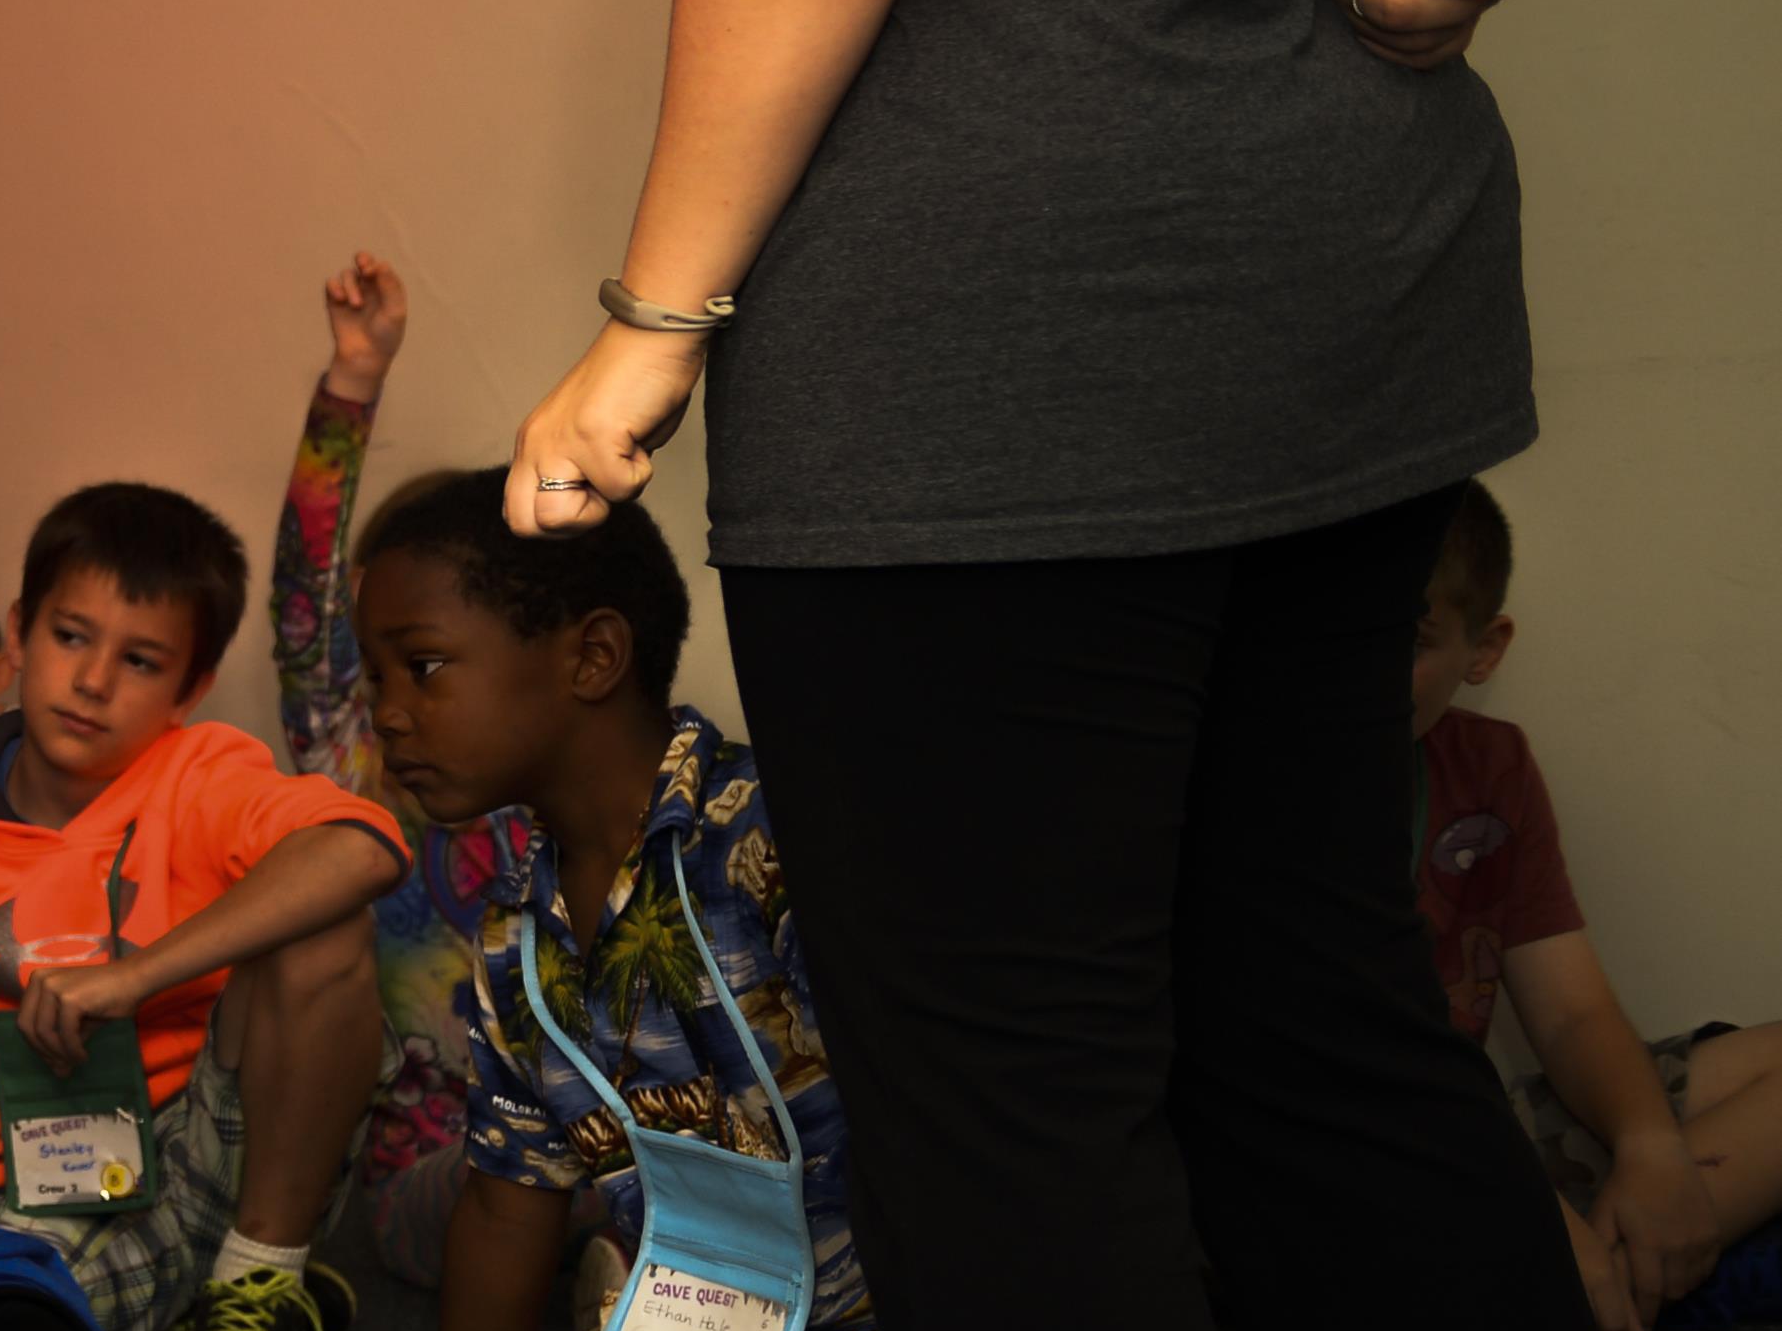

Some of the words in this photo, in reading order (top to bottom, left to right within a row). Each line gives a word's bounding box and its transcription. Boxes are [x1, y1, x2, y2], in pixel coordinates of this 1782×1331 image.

[653, 1282, 692, 1300] CAVE
[696, 1288, 739, 1309] QUEST
[643, 1300, 693, 1326] Ethan
